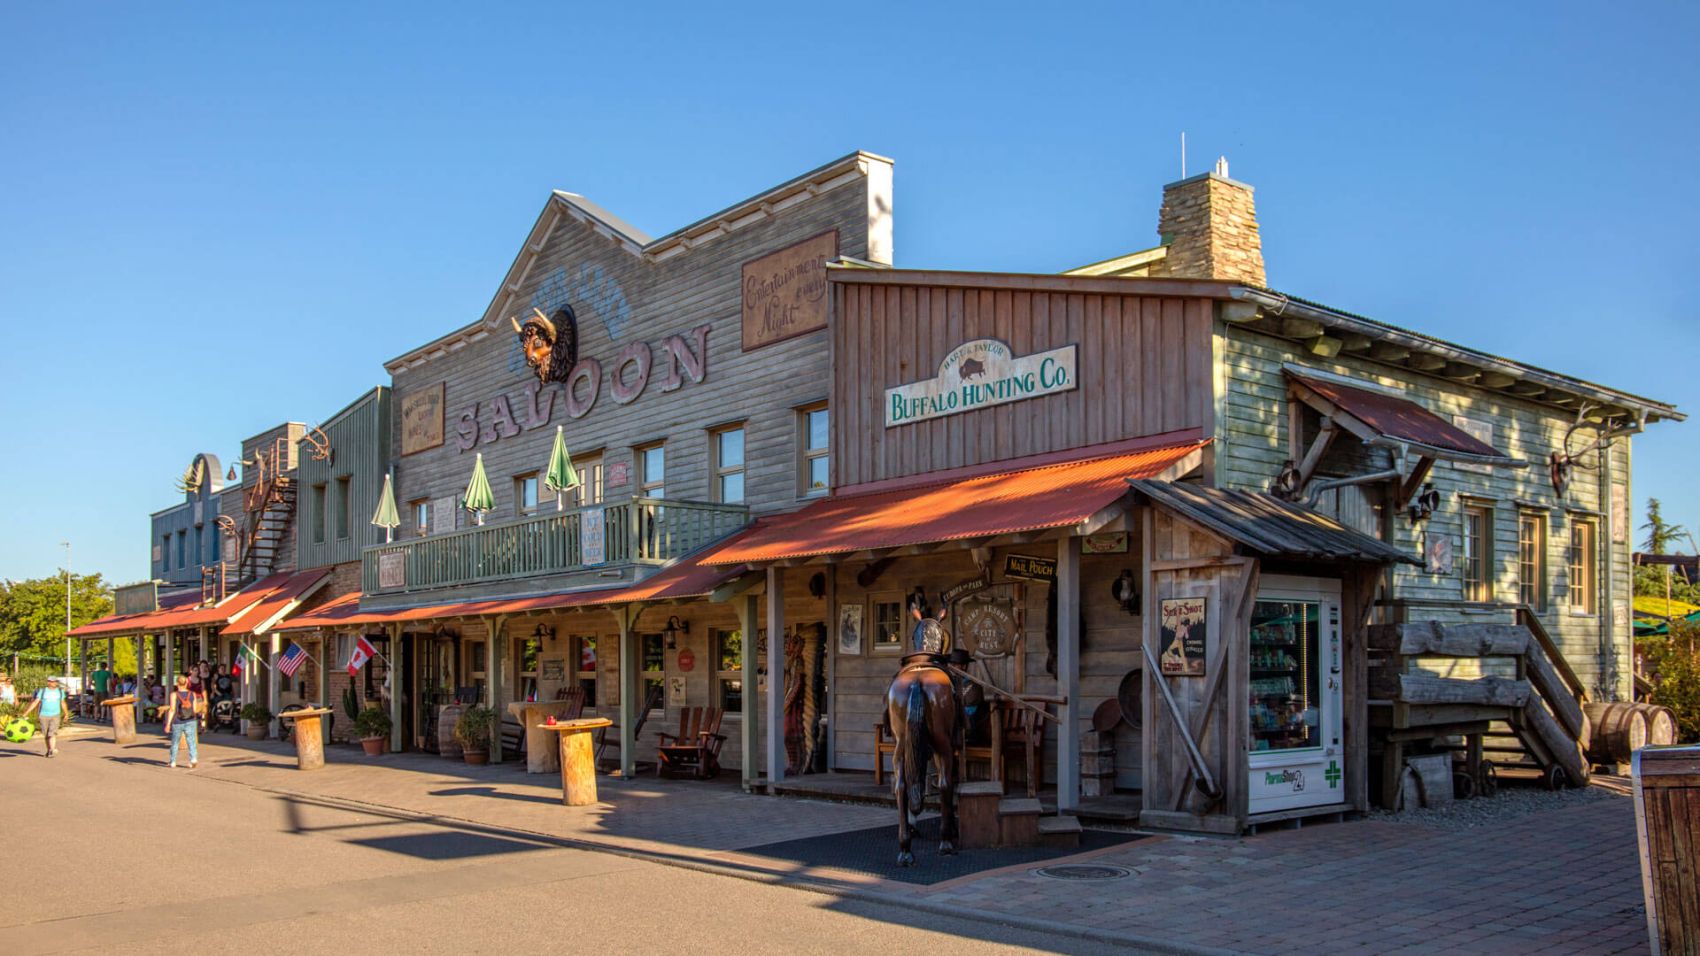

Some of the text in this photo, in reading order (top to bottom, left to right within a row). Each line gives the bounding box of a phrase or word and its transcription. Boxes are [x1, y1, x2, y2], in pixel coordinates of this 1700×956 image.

[745, 255, 826, 310] Entertainment
[757, 295, 801, 337] Night
[456, 323, 713, 454] SALOON
[892, 358, 1070, 421] BUFFALO HUNTING Co.
[1029, 560, 1053, 576] POUCH
[1183, 602, 1202, 616] SHOT
